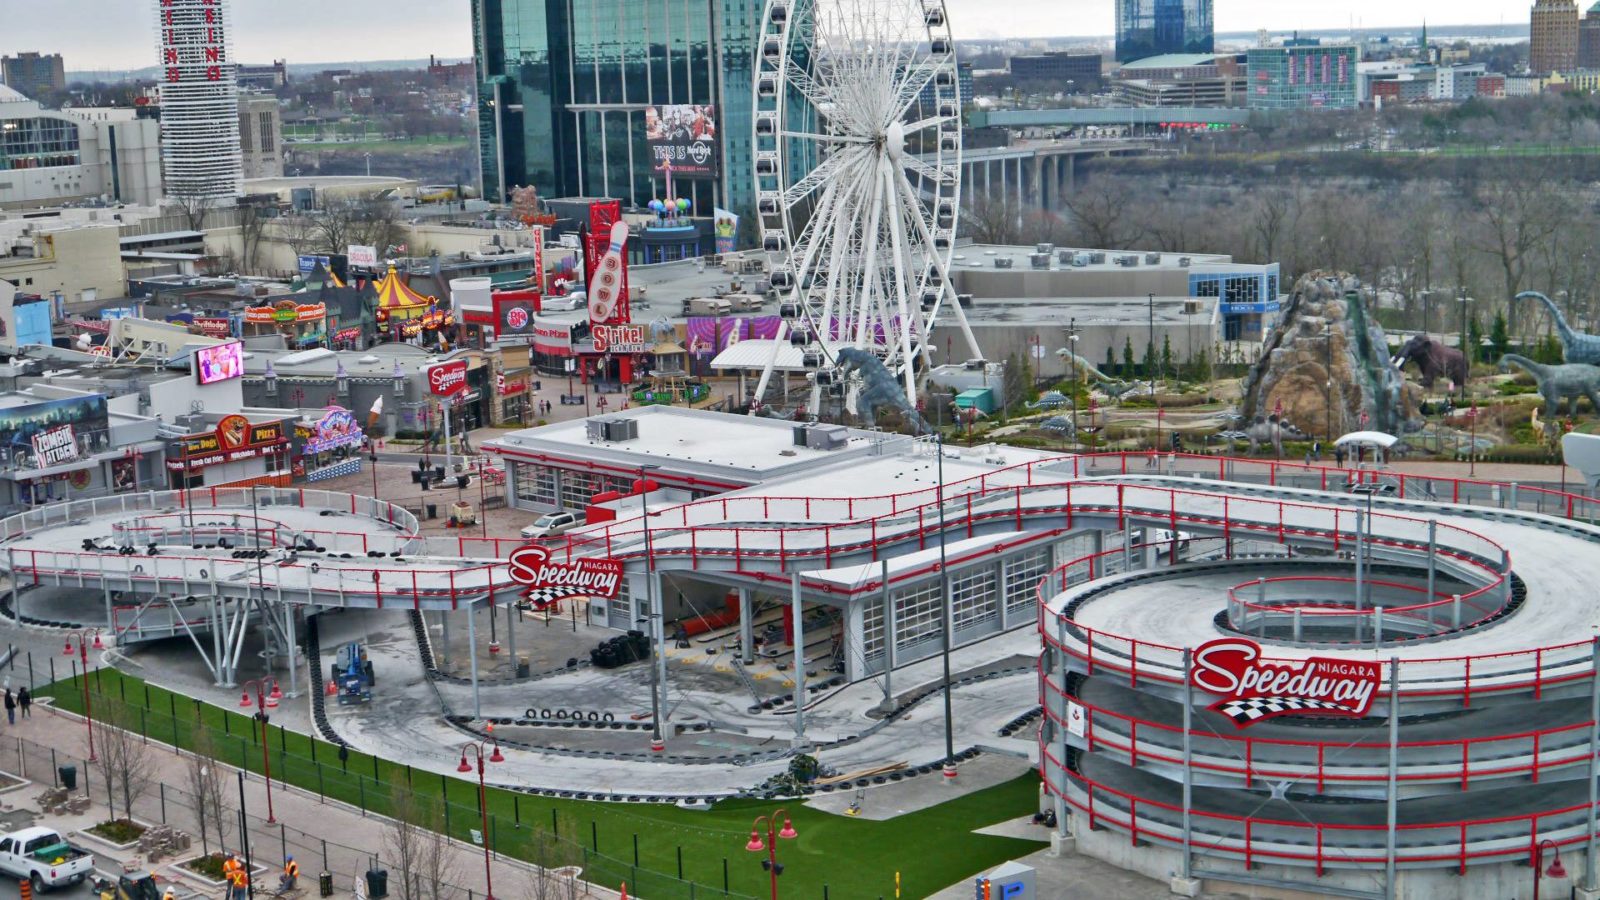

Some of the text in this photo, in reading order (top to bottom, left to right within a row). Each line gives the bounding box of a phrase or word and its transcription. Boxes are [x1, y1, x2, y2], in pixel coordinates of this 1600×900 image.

[653, 145, 675, 160] THIS
[676, 145, 686, 160] IS
[193, 319, 228, 332] Thriftlodge
[593, 325, 644, 352] Strike!
[432, 368, 465, 385] Speedway
[200, 439, 217, 449] Dogs
[45, 442, 78, 464] ATTACK
[509, 548, 618, 597] Speedway
[583, 562, 619, 571] NIAGARA
[1194, 643, 1375, 713] Speedway
[1318, 663, 1375, 677] NIAGARA
[1002, 881, 1025, 900] P
